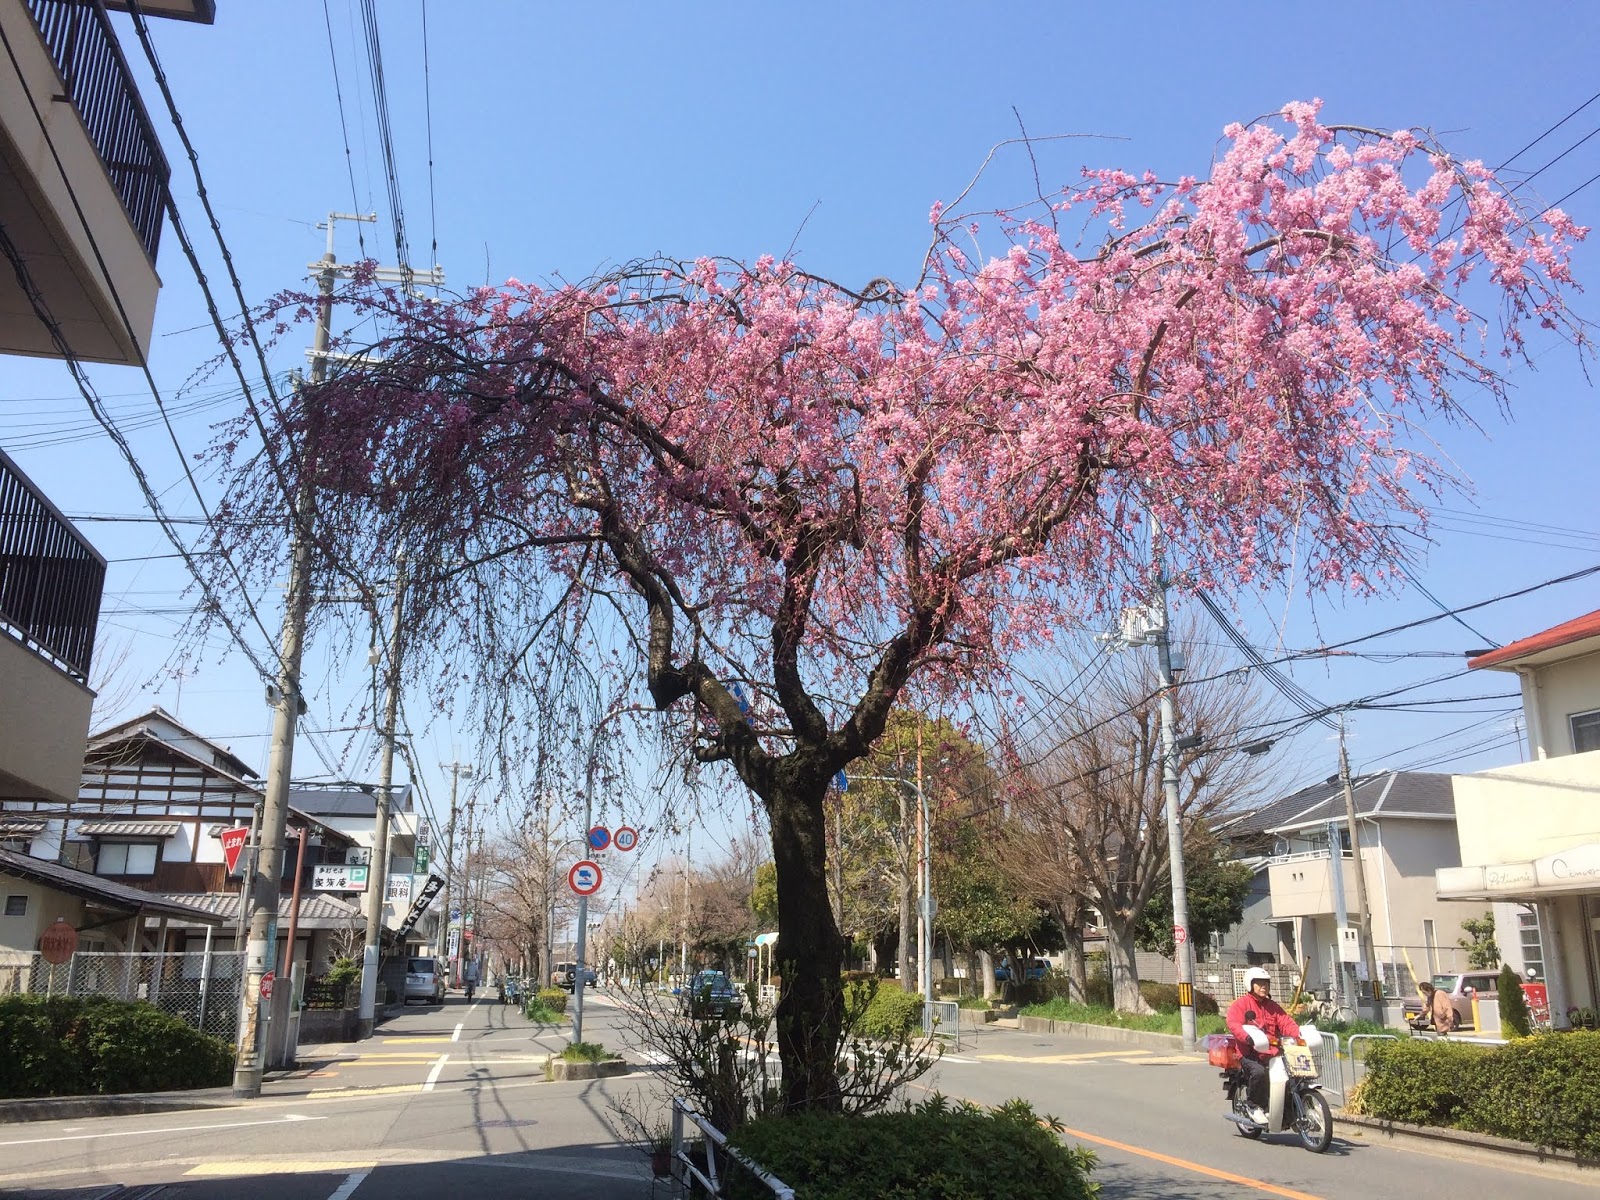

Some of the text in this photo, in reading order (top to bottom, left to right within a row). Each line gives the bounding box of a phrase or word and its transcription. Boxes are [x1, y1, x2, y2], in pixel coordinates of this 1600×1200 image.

[225, 837, 242, 849] 止まれ
[619, 834, 632, 845] 40
[352, 868, 365, 880] P
[314, 877, 347, 888] 家族庵
[388, 880, 409, 888] おかだ
[388, 887, 409, 898] 眼科
